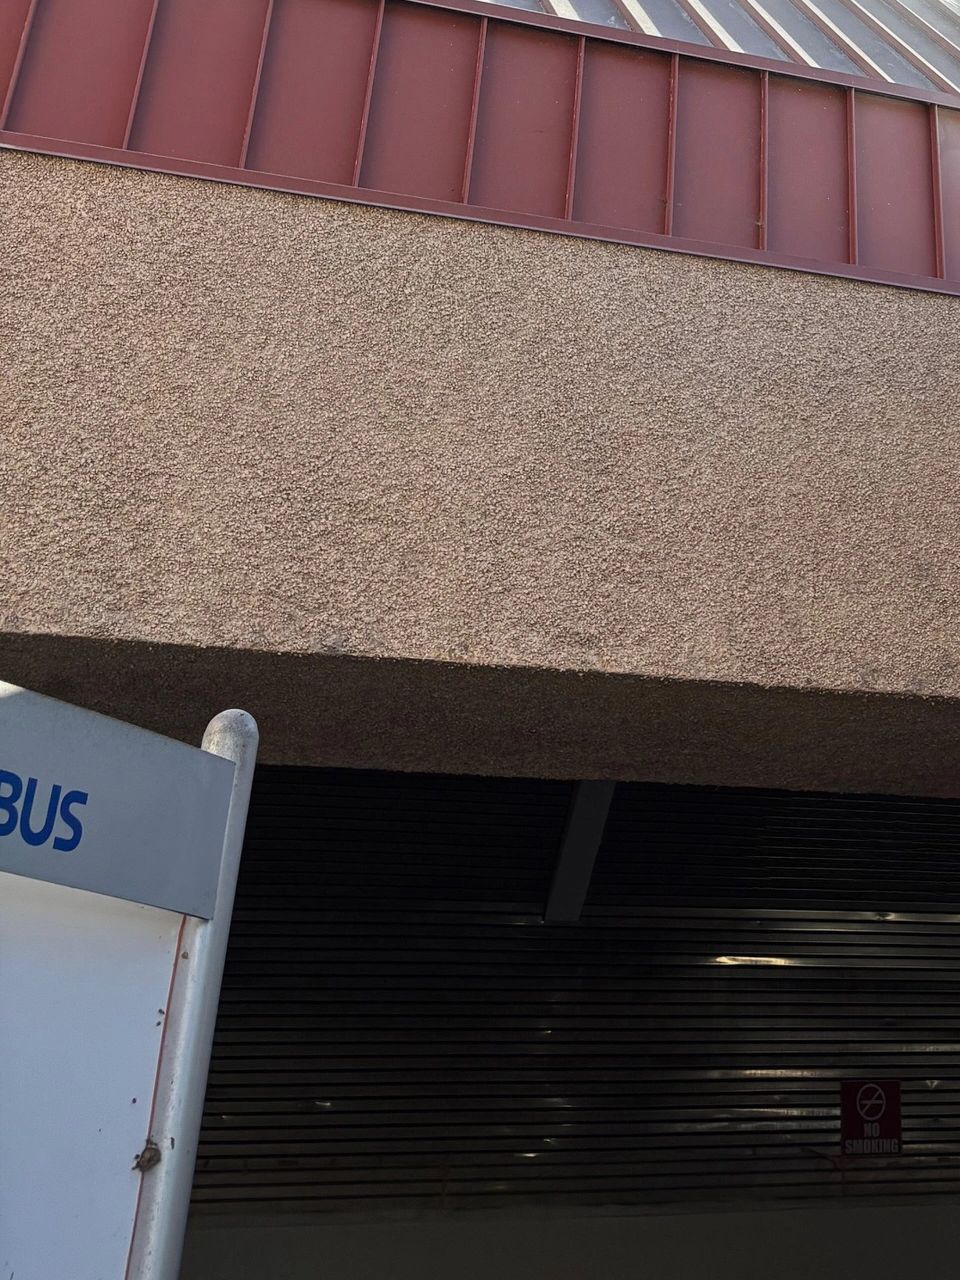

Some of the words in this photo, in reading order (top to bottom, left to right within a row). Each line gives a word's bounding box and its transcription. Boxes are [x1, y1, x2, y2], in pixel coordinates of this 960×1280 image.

[0, 769, 89, 852] BUS
[863, 1122, 880, 1138] NO
[844, 1138, 899, 1154] SMOKING
